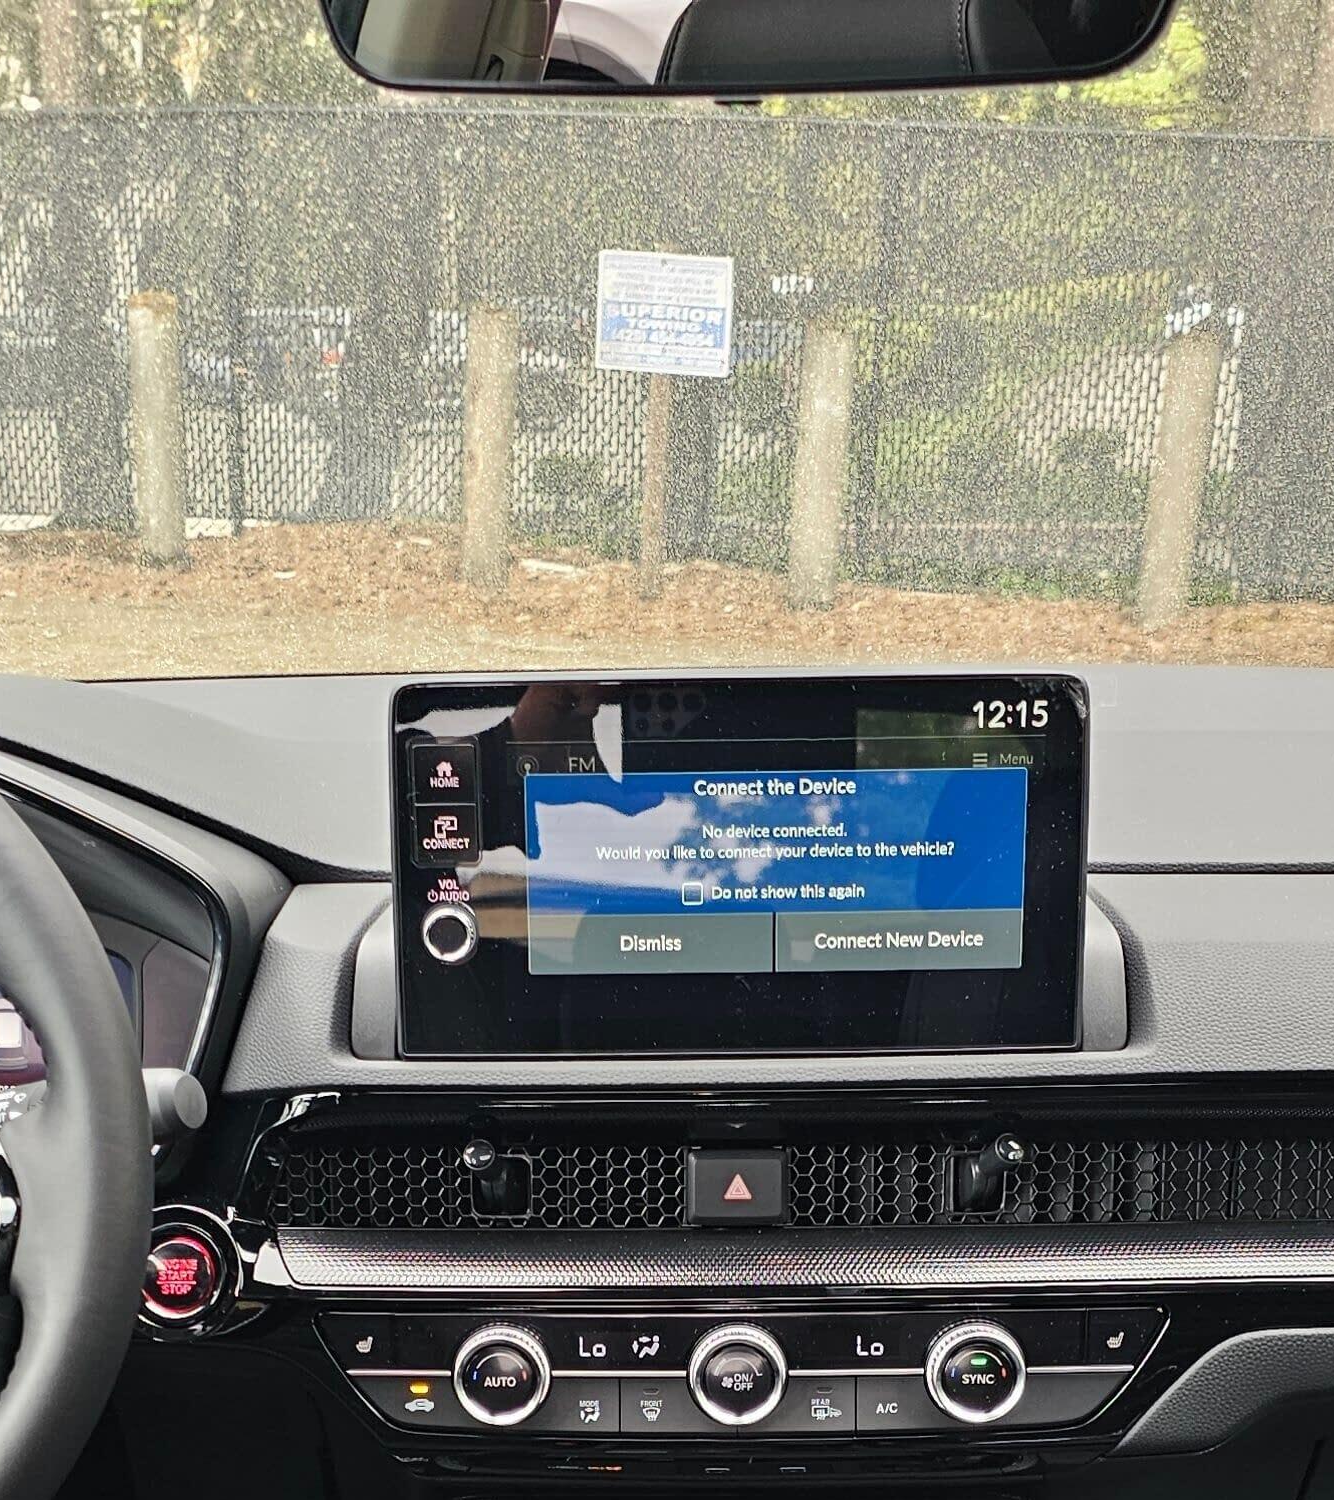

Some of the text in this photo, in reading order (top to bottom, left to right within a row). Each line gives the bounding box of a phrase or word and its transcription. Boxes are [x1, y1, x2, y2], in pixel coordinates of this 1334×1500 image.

[972, 699, 1049, 729] 12:15
[568, 756, 596, 773] FM
[999, 752, 1034, 765] Menu
[430, 777, 459, 788] HOME
[694, 778, 857, 796] Connect the Device
[702, 823, 848, 839] No device connected.
[423, 838, 470, 850] CONNECT
[596, 841, 955, 863] Would you like to connect your device to the vehicle?
[438, 879, 459, 890] VOL
[439, 891, 469, 902] AUDIO
[711, 884, 865, 900] Do not show this again
[620, 935, 682, 952] Dismiss
[814, 930, 984, 950] Connect New Device
[158, 1271, 195, 1281] START
[161, 1284, 192, 1295] STOP
[484, 1376, 517, 1388] AUTO
[734, 1373, 753, 1383] ON/
[961, 1374, 996, 1385] SYNC
[733, 1382, 753, 1392] OFF
[875, 1402, 898, 1414] A/C
